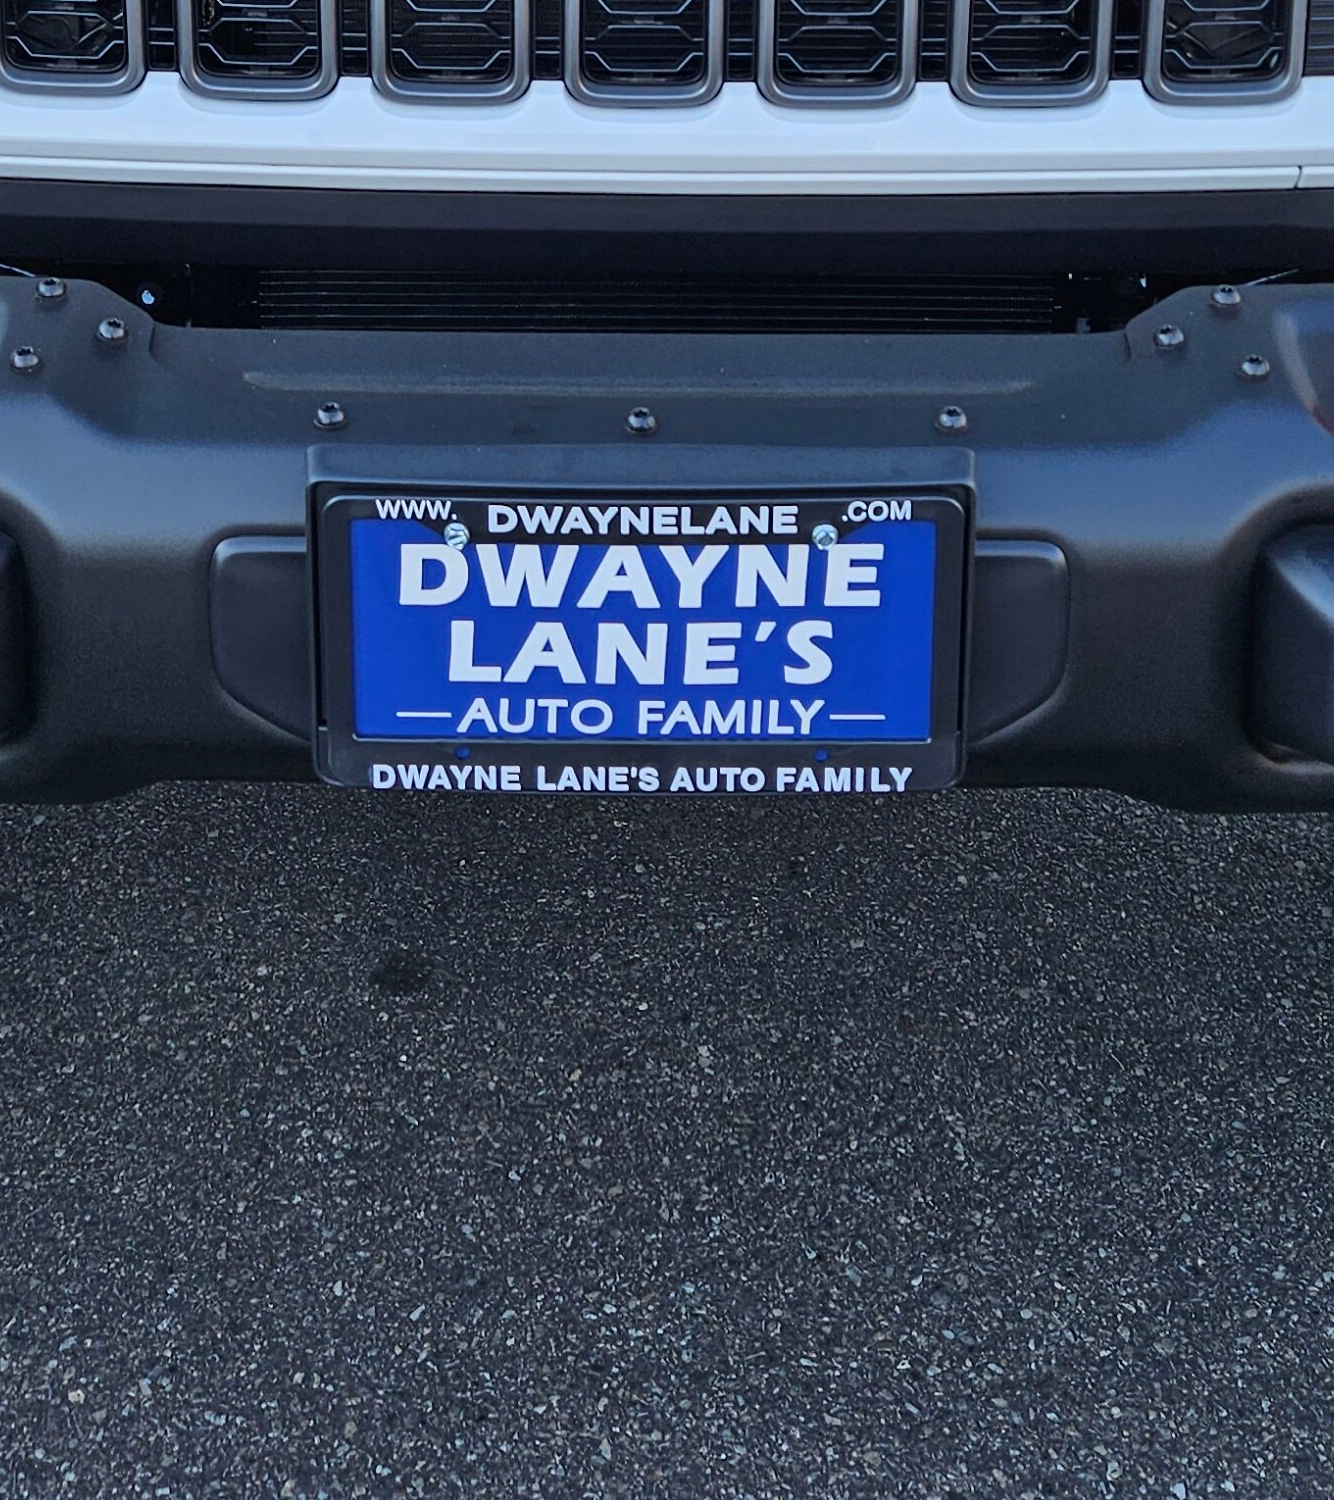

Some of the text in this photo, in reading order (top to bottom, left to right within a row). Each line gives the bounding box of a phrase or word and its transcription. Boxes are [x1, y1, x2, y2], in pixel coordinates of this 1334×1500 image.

[375, 498, 913, 537] WWW. DWAYNELANE .COM
[399, 542, 885, 608] DWAYNE
[448, 619, 835, 685] LANE'S
[456, 696, 824, 735] AUTO FAMILY
[371, 763, 913, 794] DWAYNE LANE'S AUTO FAMILY
